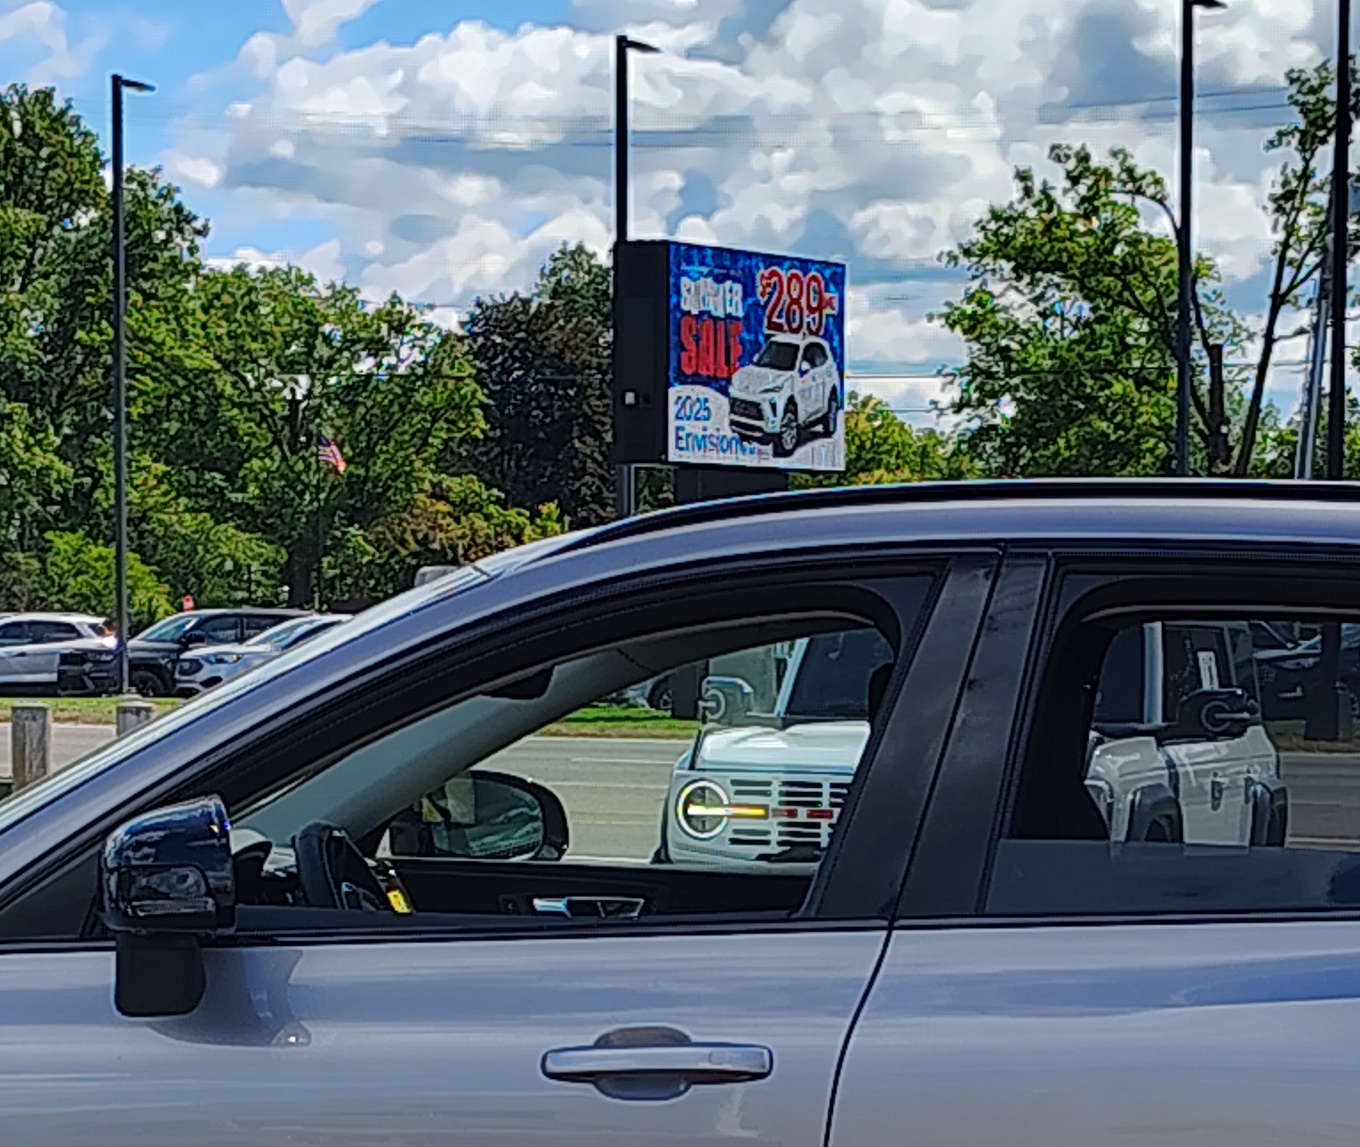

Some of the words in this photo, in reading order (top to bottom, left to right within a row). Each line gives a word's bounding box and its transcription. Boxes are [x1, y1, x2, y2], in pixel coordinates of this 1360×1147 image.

[680, 315, 743, 378] SALE
[674, 395, 712, 421] 2025
[674, 425, 741, 454] Envision
